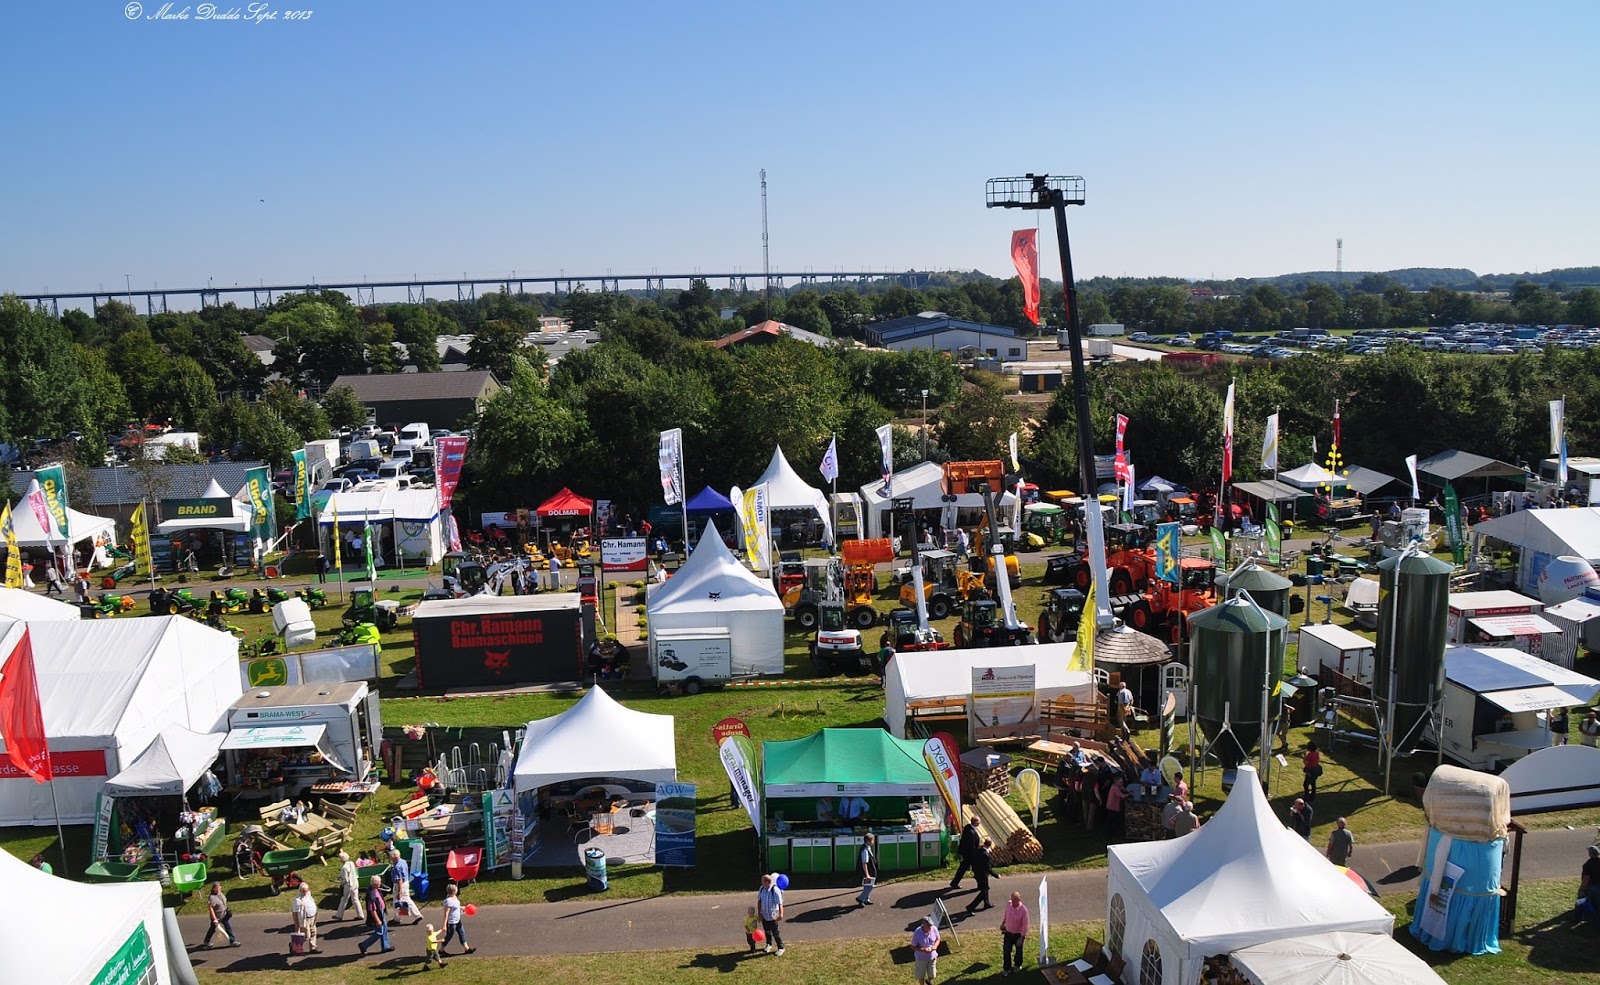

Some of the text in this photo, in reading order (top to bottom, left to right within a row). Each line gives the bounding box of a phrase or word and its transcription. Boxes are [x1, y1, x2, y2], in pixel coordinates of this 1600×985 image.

[177, 505, 217, 515] BRAND
[602, 541, 616, 549] Chr.
[450, 618, 543, 635] Chr. Hamann
[451, 632, 544, 648] Baumaschinen
[259, 710, 305, 718] BRAMA-WEST
[723, 747, 754, 803] agrarmanager
[657, 784, 685, 795] AGW
